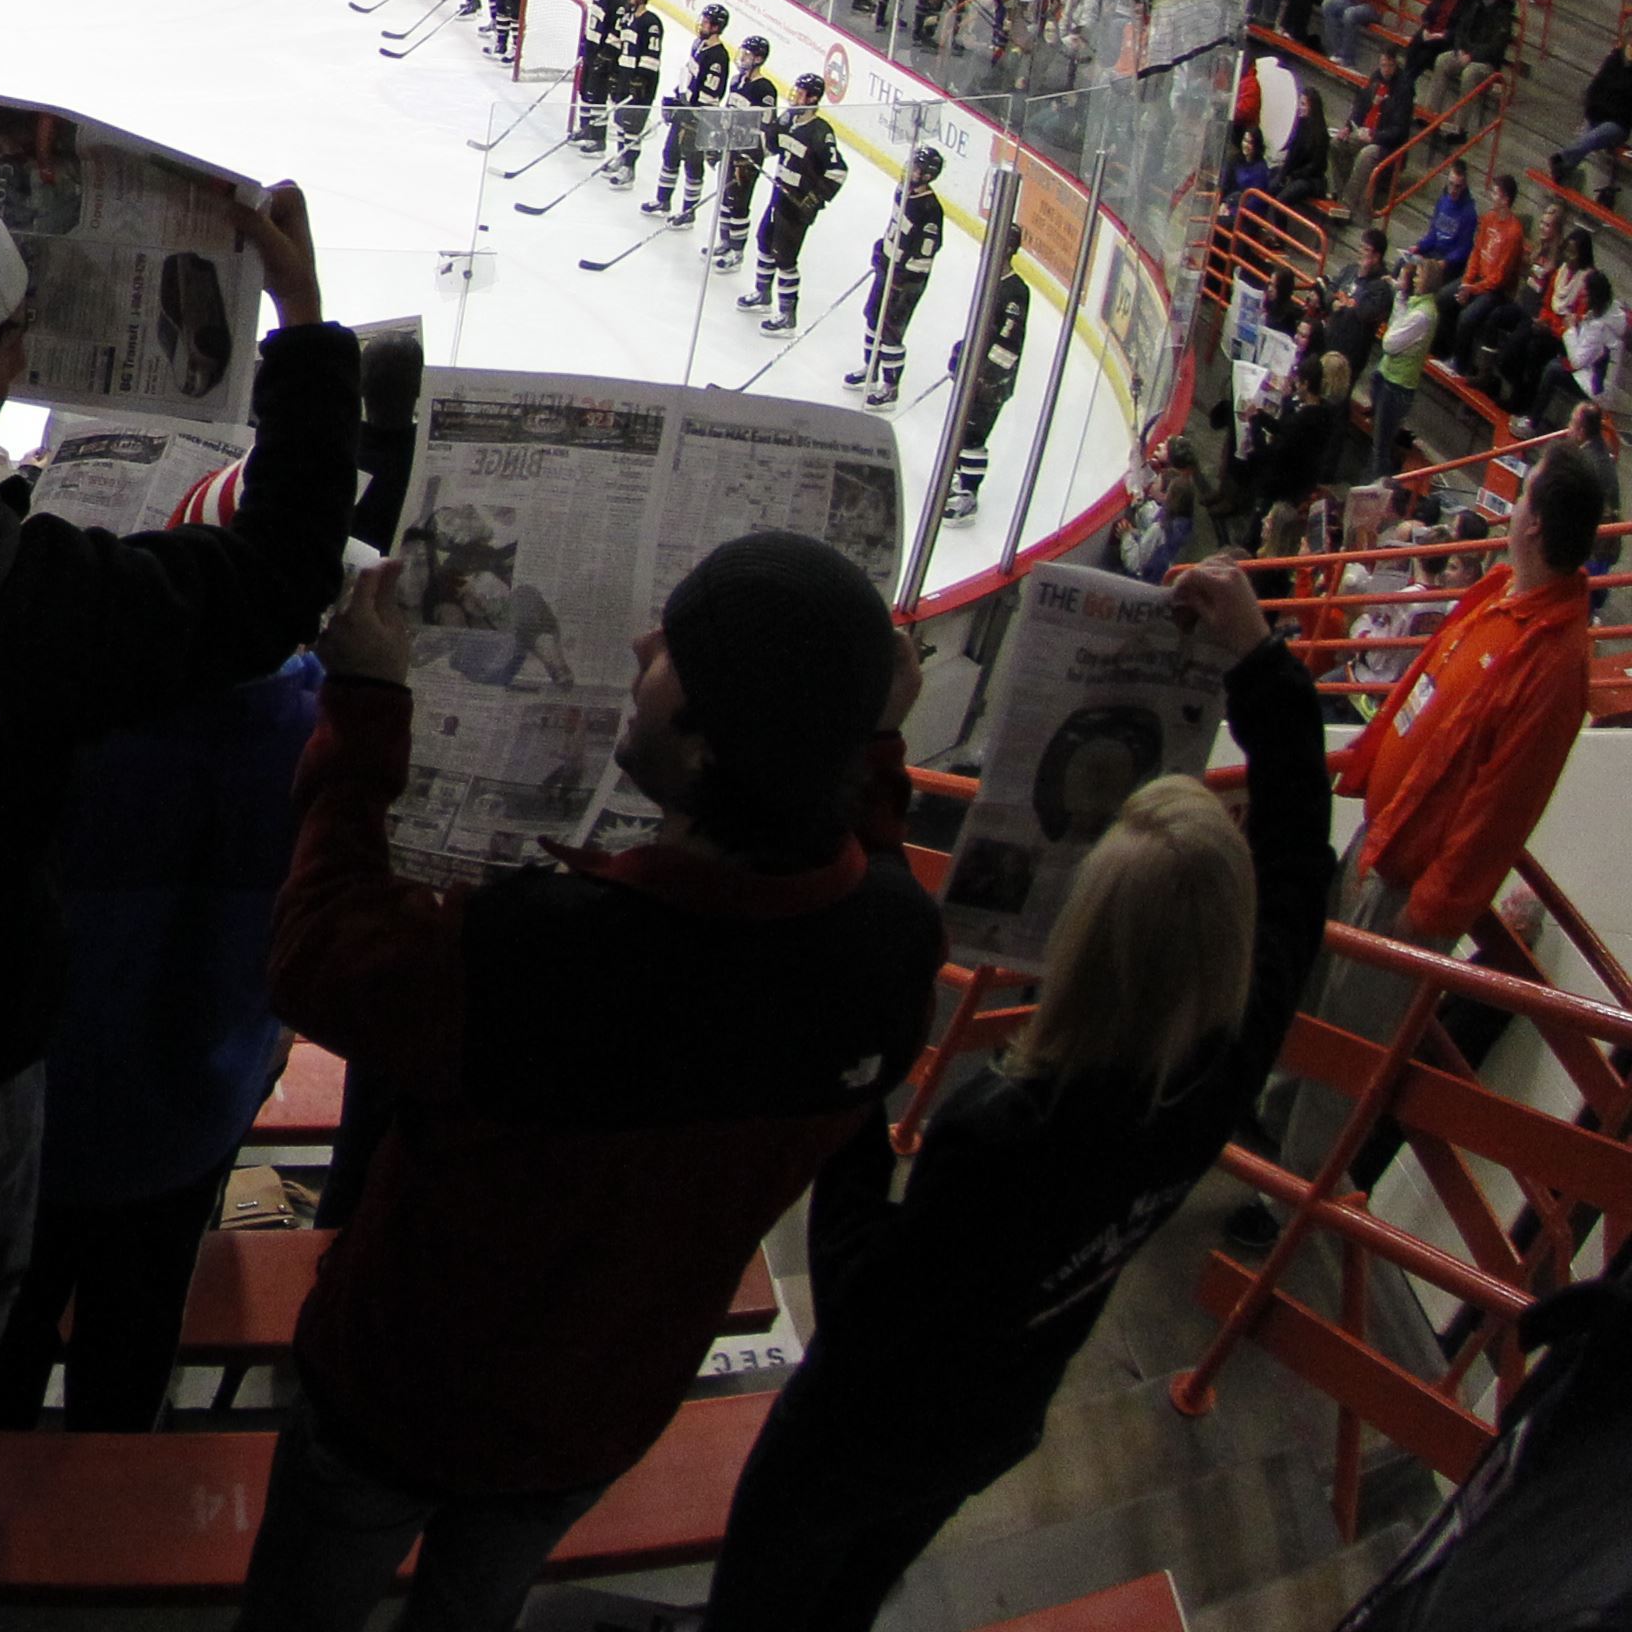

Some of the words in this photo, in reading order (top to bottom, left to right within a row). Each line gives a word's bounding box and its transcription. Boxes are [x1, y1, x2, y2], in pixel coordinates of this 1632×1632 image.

[869, 73, 903, 108] THE
[124, 324, 140, 369] Transit
[119, 373, 132, 394] BG
[1039, 582, 1080, 613] THE
[1083, 592, 1116, 621] BG
[711, 1346, 786, 1375] SEC
[190, 1482, 250, 1534] 14
